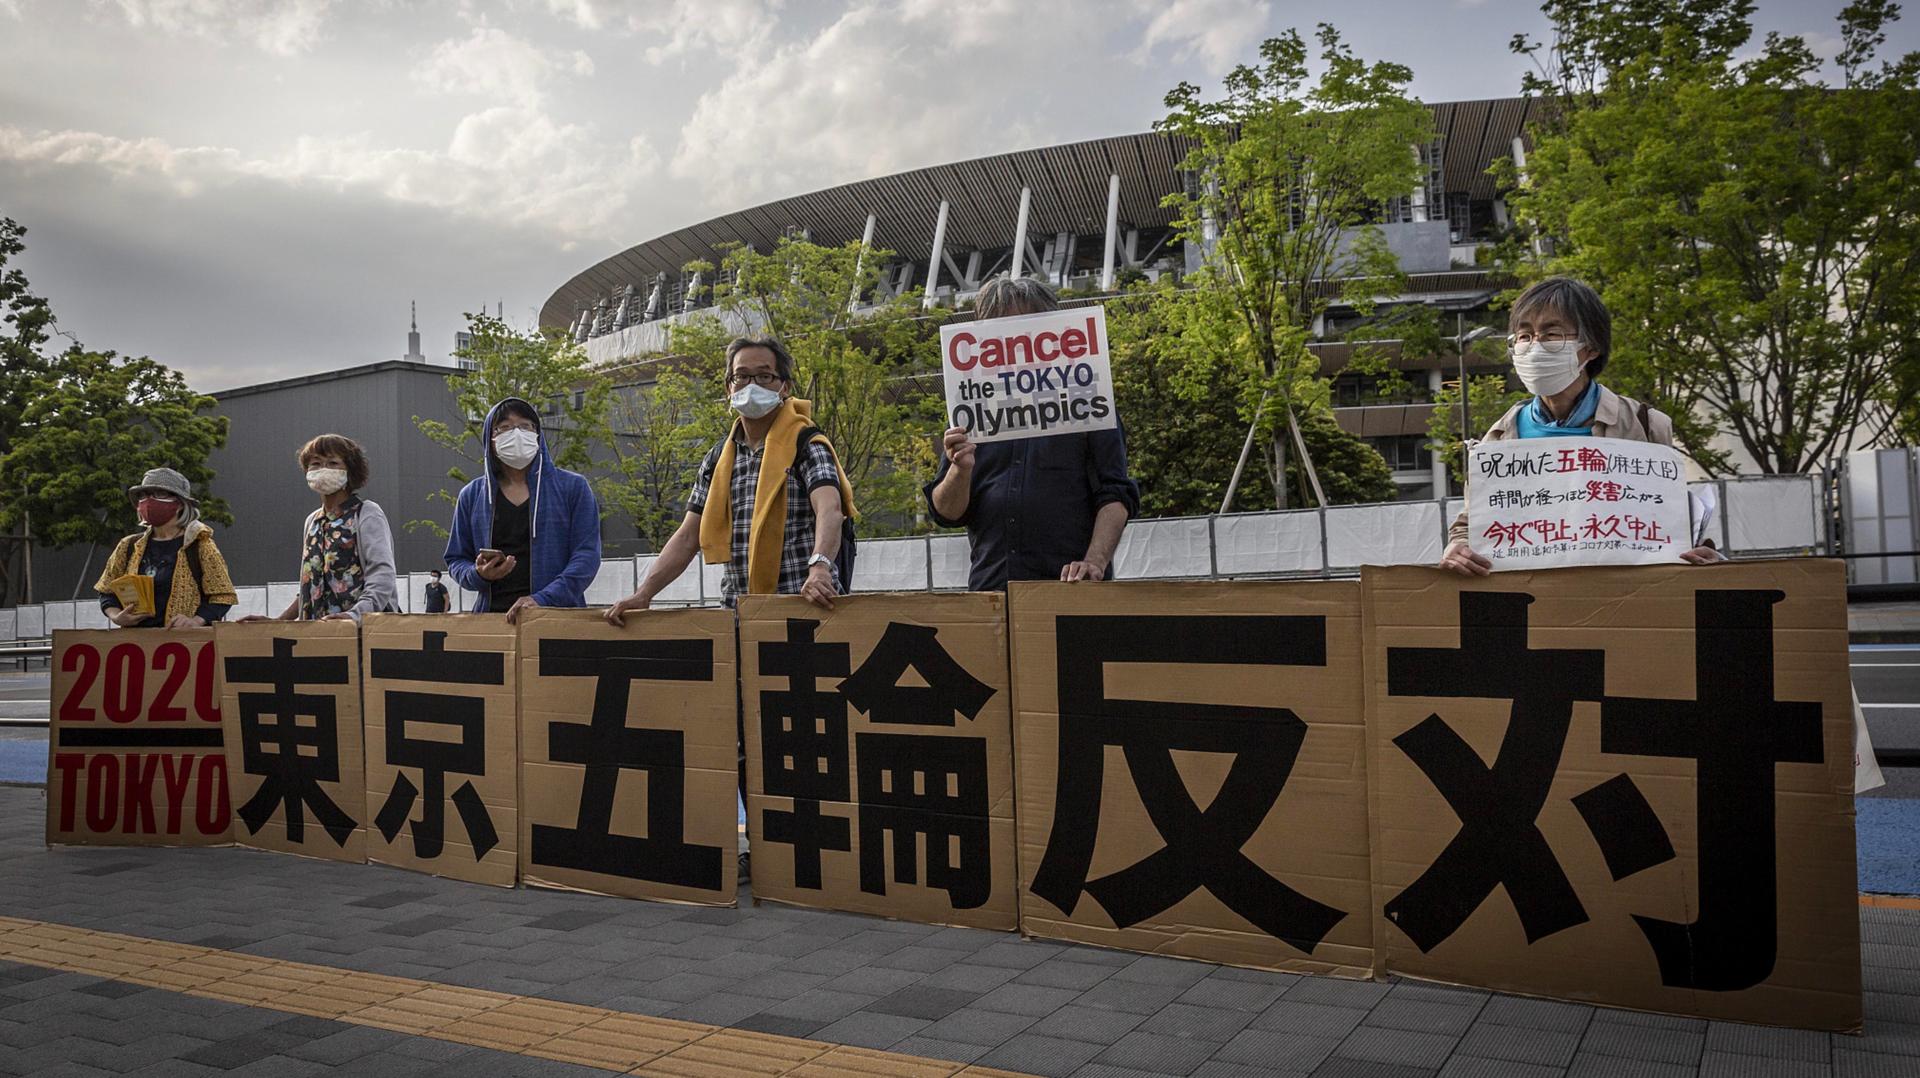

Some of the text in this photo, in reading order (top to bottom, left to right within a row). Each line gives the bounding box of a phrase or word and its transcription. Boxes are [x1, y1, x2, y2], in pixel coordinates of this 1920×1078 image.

[949, 317, 1099, 371] Cancel
[959, 363, 1093, 401] the TOKYO
[952, 393, 1110, 436] Olympics
[1489, 480, 1664, 509] 時間が経つほど災害広がる
[55, 753, 231, 835] TOKYO
